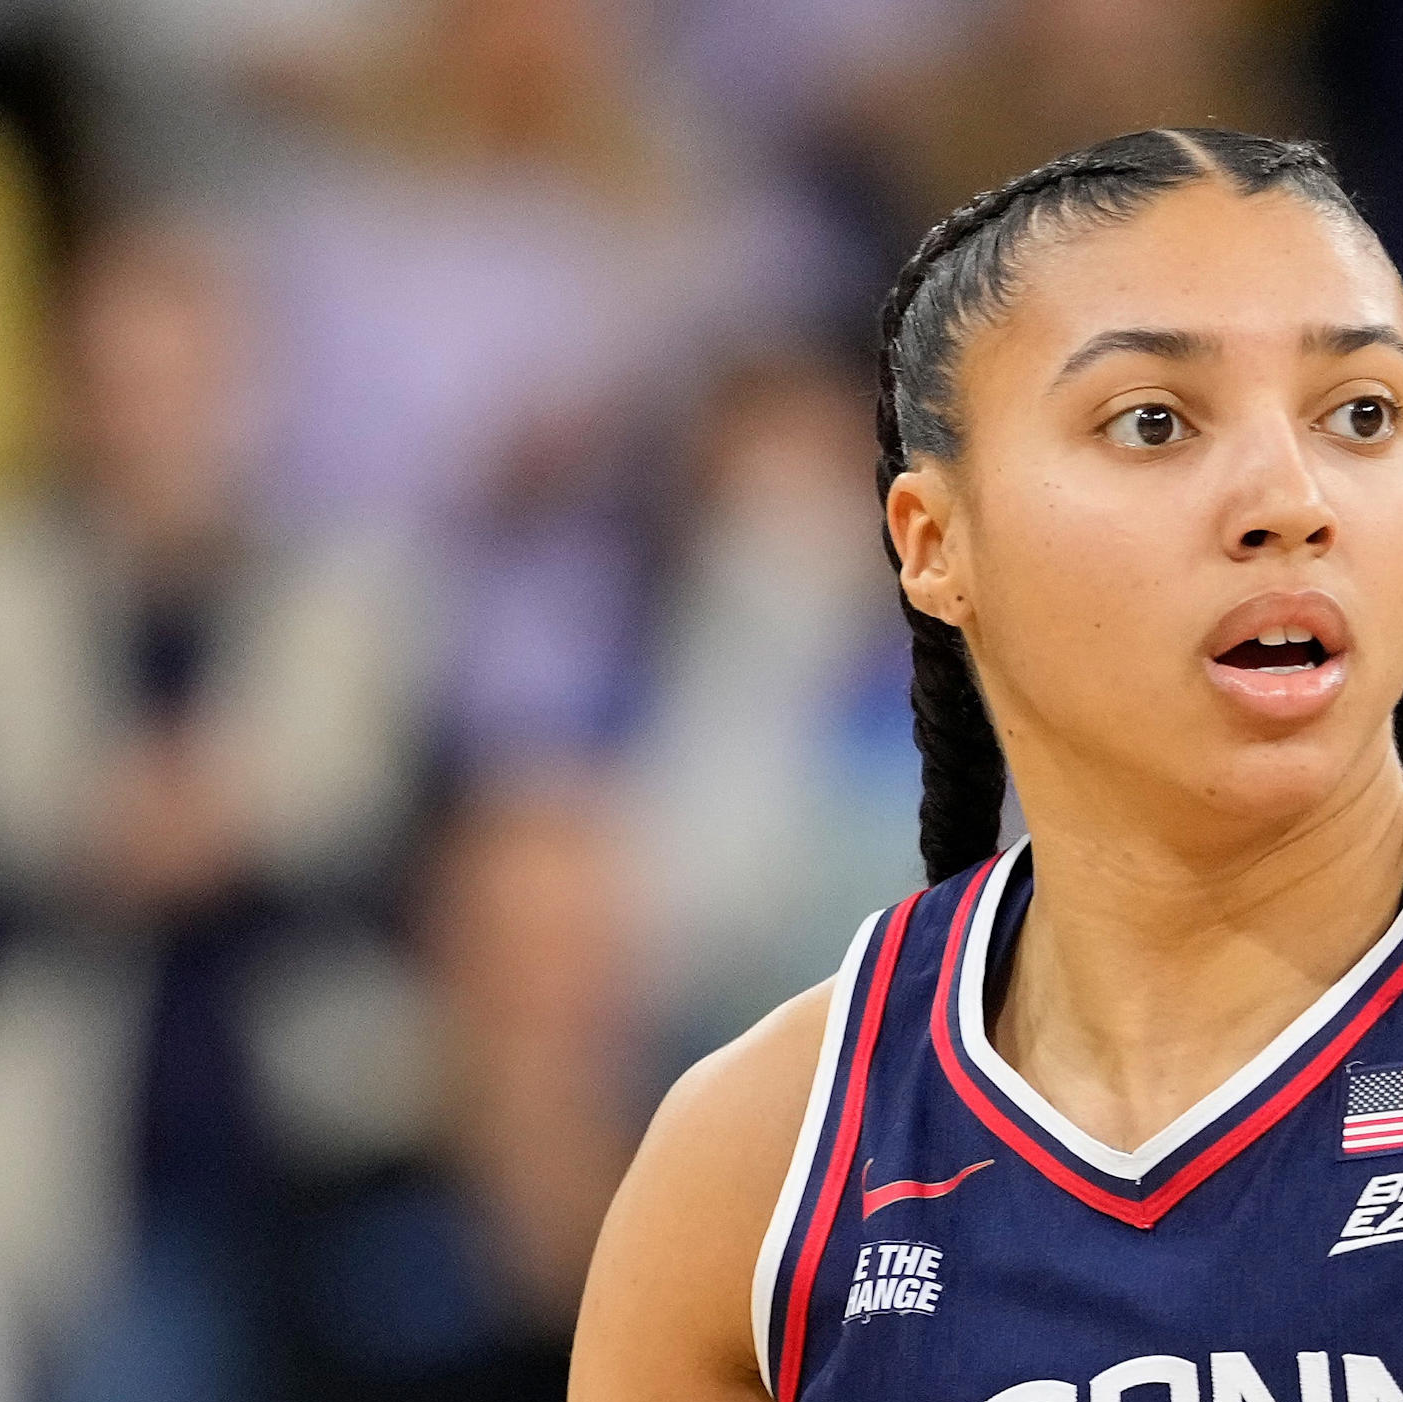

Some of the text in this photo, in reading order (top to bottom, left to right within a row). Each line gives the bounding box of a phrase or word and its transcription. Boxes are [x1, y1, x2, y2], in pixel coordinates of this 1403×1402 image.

[853, 1244, 944, 1282] E THE
[844, 1277, 944, 1318] HANGE
